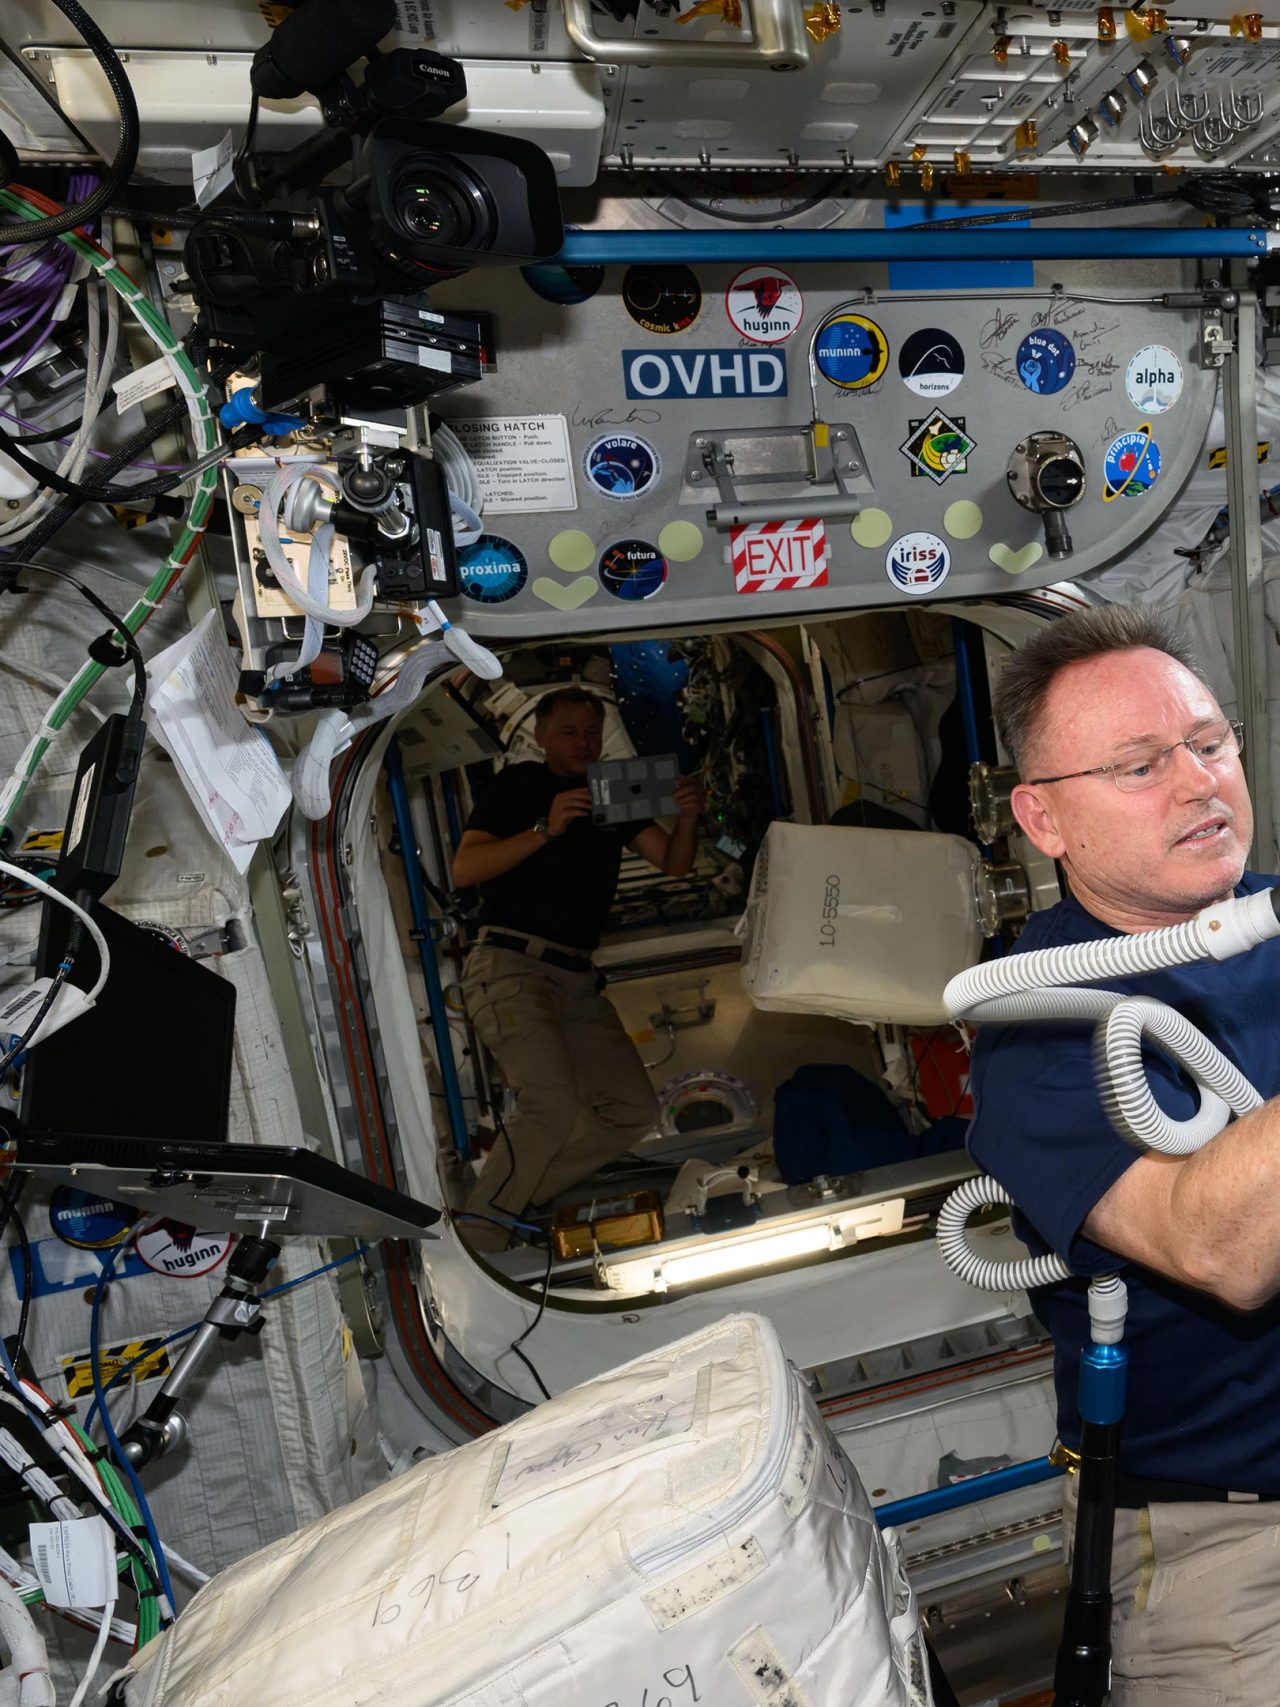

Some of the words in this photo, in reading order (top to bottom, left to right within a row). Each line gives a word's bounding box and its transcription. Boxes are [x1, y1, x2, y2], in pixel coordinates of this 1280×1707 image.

[420, 64, 450, 78] Canon
[639, 319, 671, 333] cosmic
[743, 318, 791, 334] huginn
[818, 347, 861, 359] muninn
[1028, 336, 1047, 347] blue
[1048, 342, 1060, 356] dot
[630, 354, 784, 397] OVHD
[1136, 368, 1175, 387] alpha
[919, 381, 950, 391] horizons
[504, 422, 545, 432] HATCH
[605, 438, 638, 450] volare
[1106, 434, 1146, 464] principia
[627, 549, 656, 560] futura
[746, 534, 811, 575] EXIT
[900, 545, 938, 563] iriss
[460, 562, 521, 579] proxima
[57, 1201, 115, 1221] muninn
[163, 1242, 222, 1272] huginn
